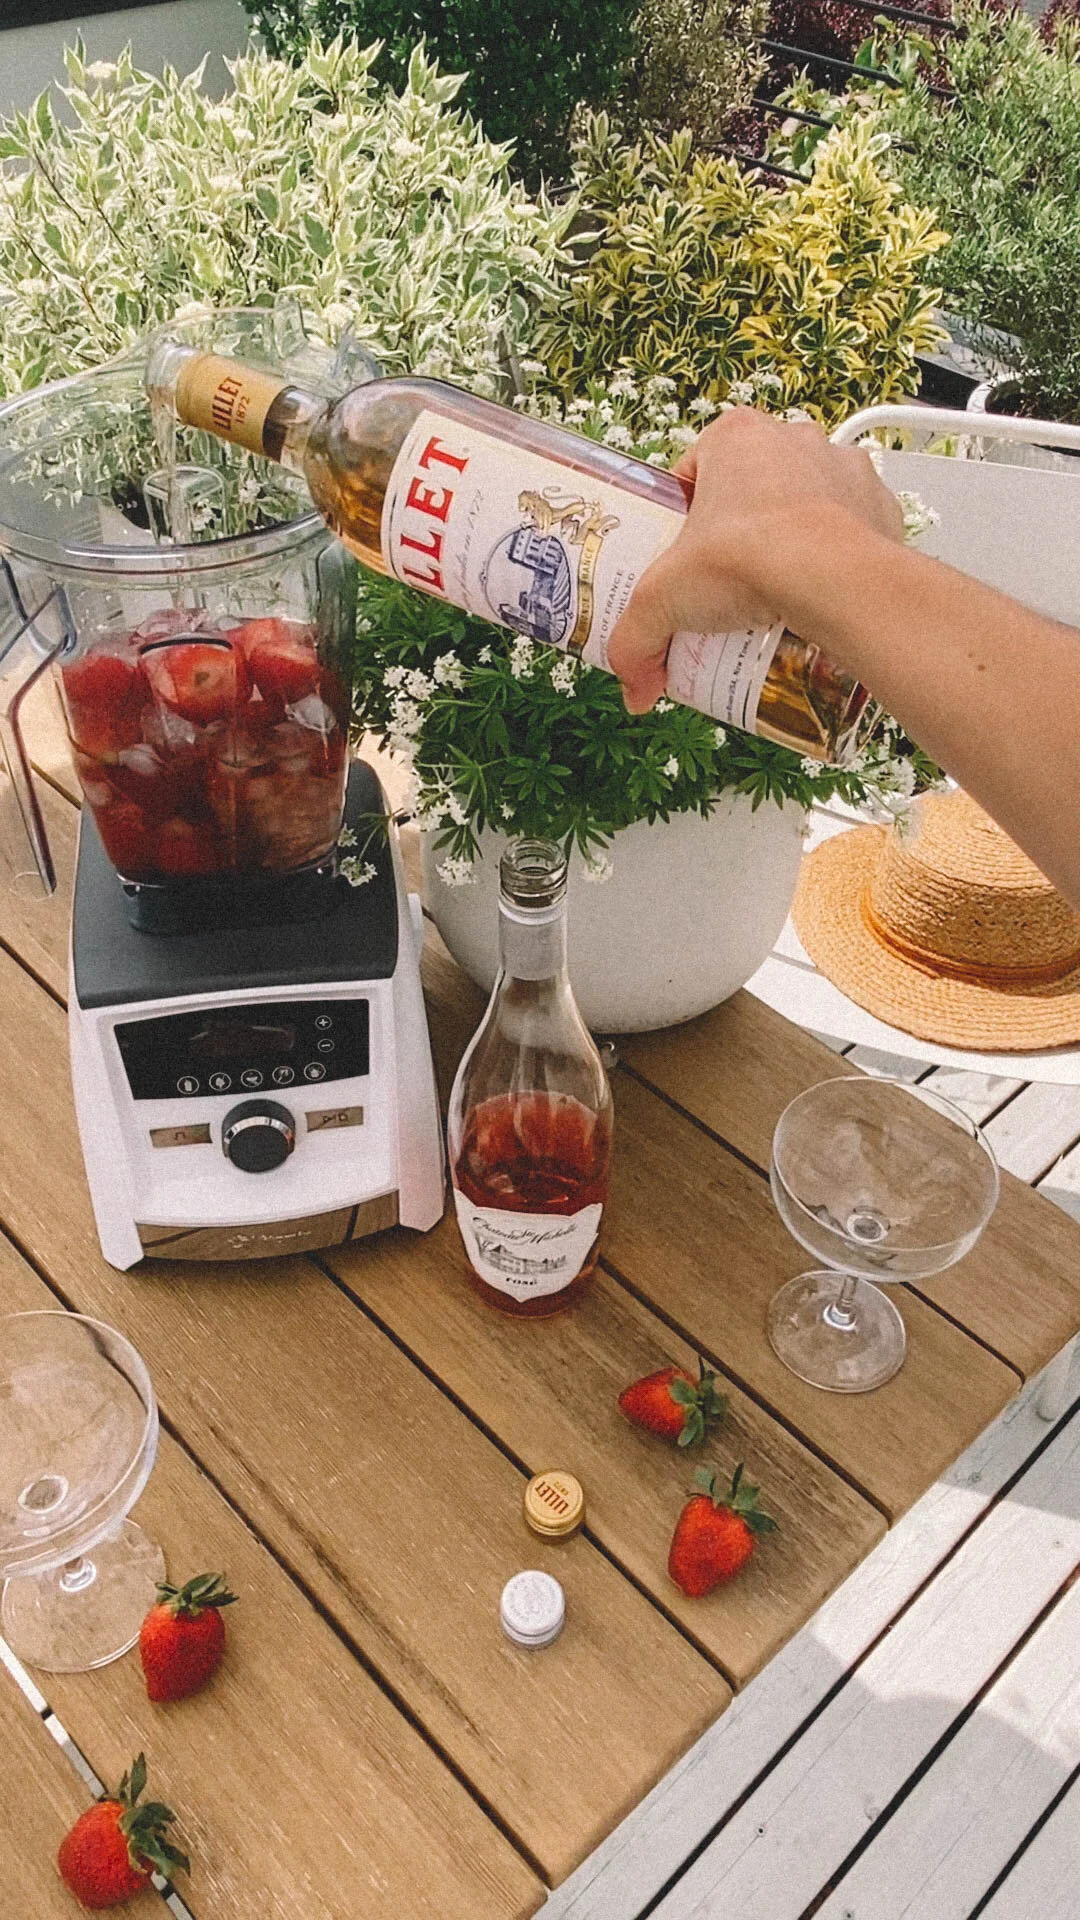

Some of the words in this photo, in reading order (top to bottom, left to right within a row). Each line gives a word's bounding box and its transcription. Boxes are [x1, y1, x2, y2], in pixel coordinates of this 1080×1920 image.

[212, 376, 243, 431] LILLET
[235, 396, 251, 424] 1872
[604, 570, 624, 615] FRANCE
[601, 617, 609, 632] OF
[534, 1480, 570, 1515] LILLET
